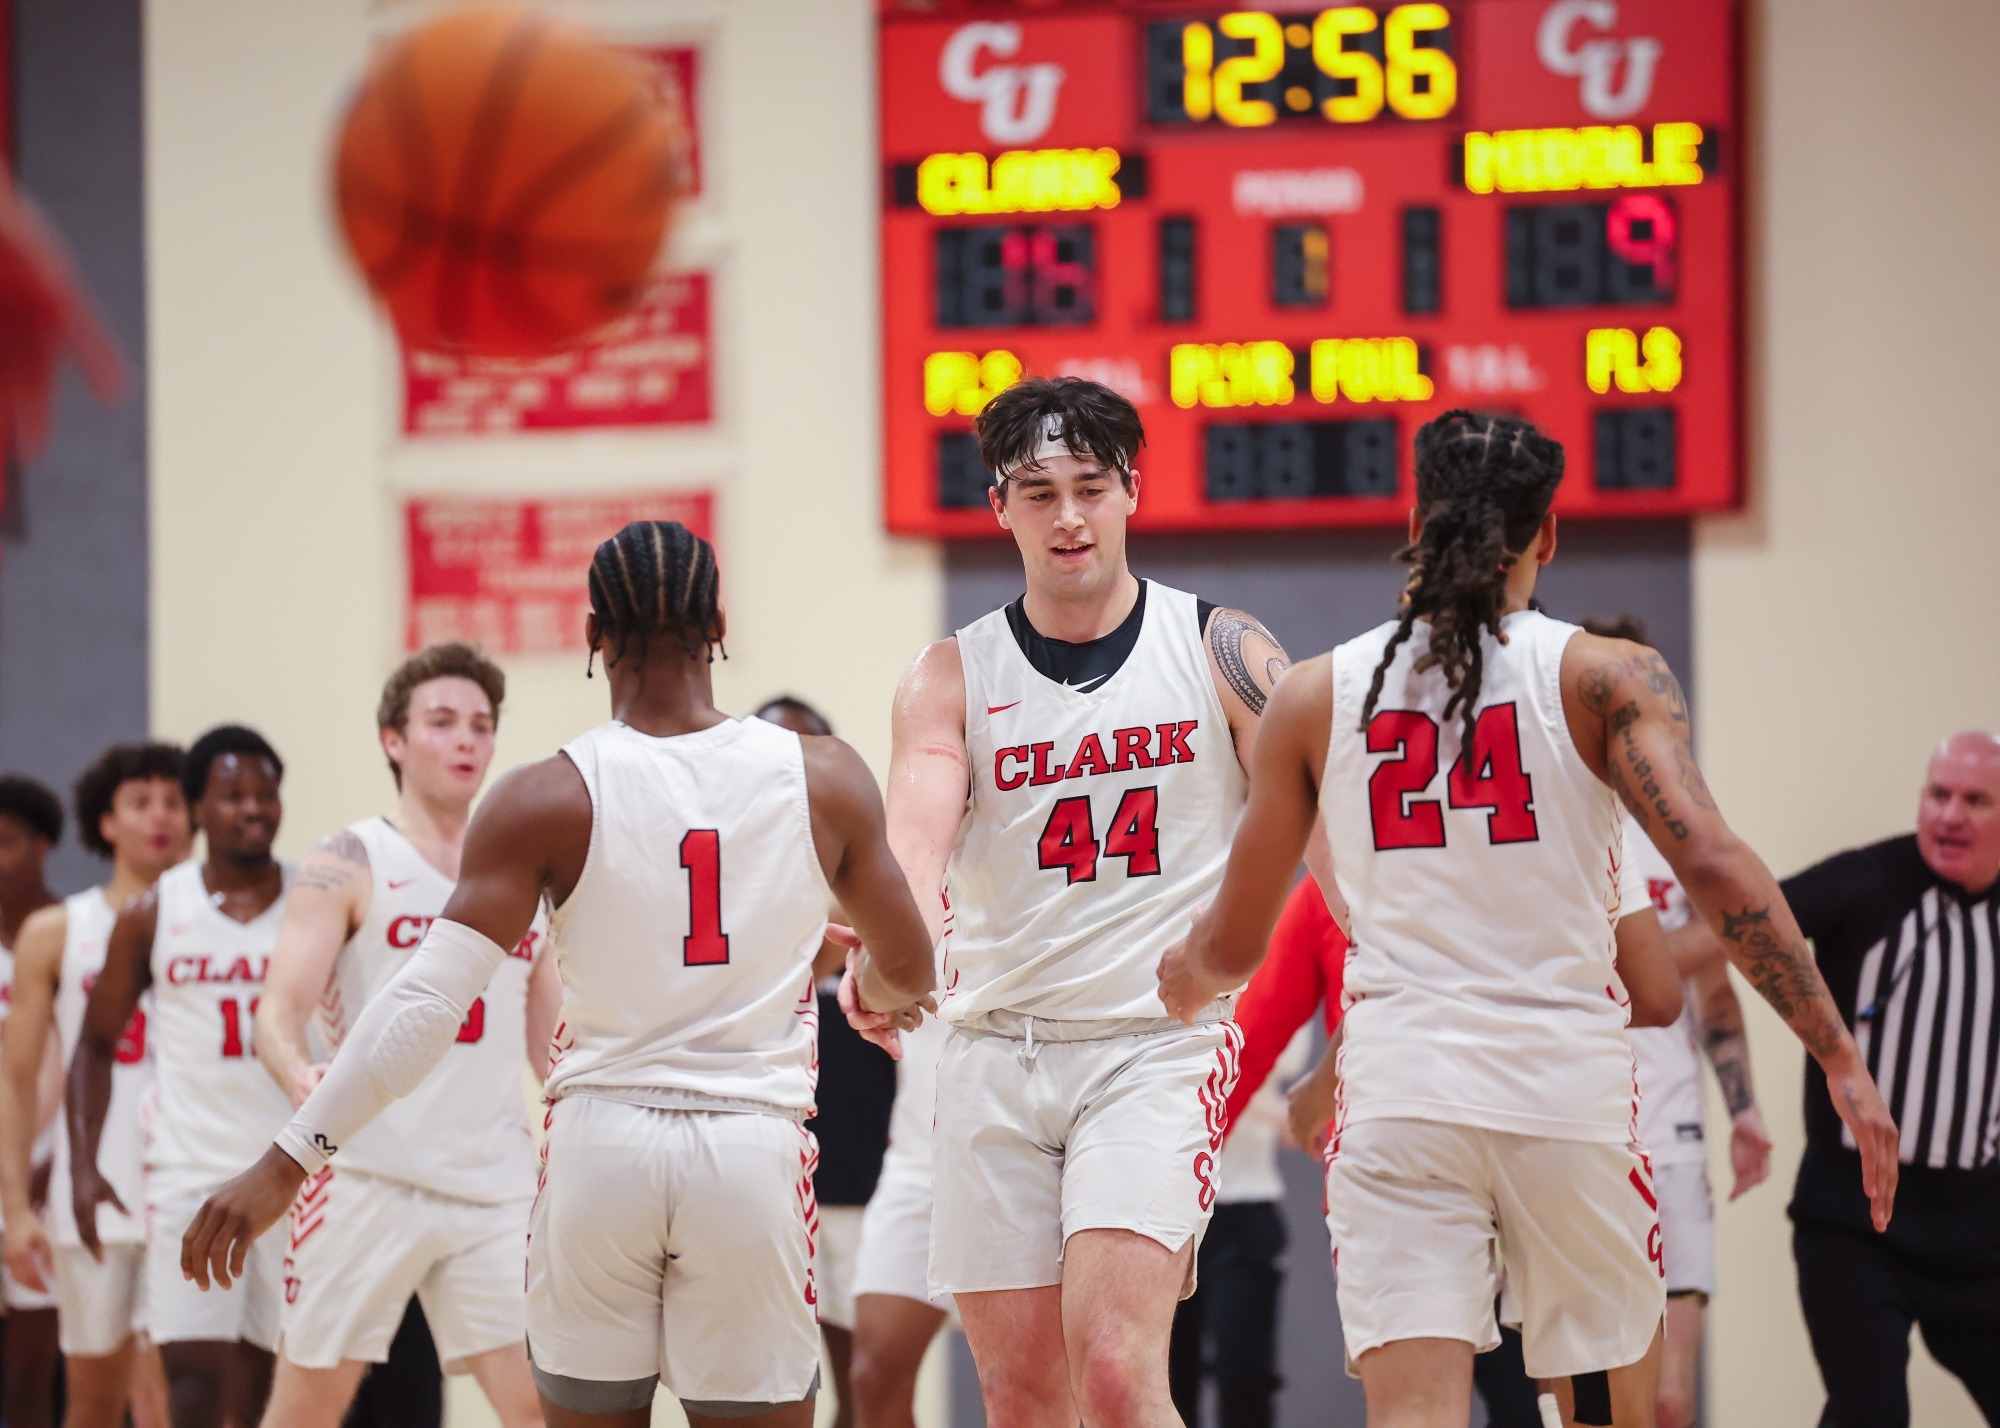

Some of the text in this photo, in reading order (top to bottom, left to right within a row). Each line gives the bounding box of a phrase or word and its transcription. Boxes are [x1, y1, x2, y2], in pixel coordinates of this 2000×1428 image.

[1183, 3, 1457, 127] 12:56
[1607, 195, 1676, 290] 9
[1586, 327, 1682, 393] FLS
[994, 720, 1199, 791] CLARK
[1366, 701, 1539, 852] 24
[1038, 785, 1161, 886] 44
[680, 829, 729, 966] 1
